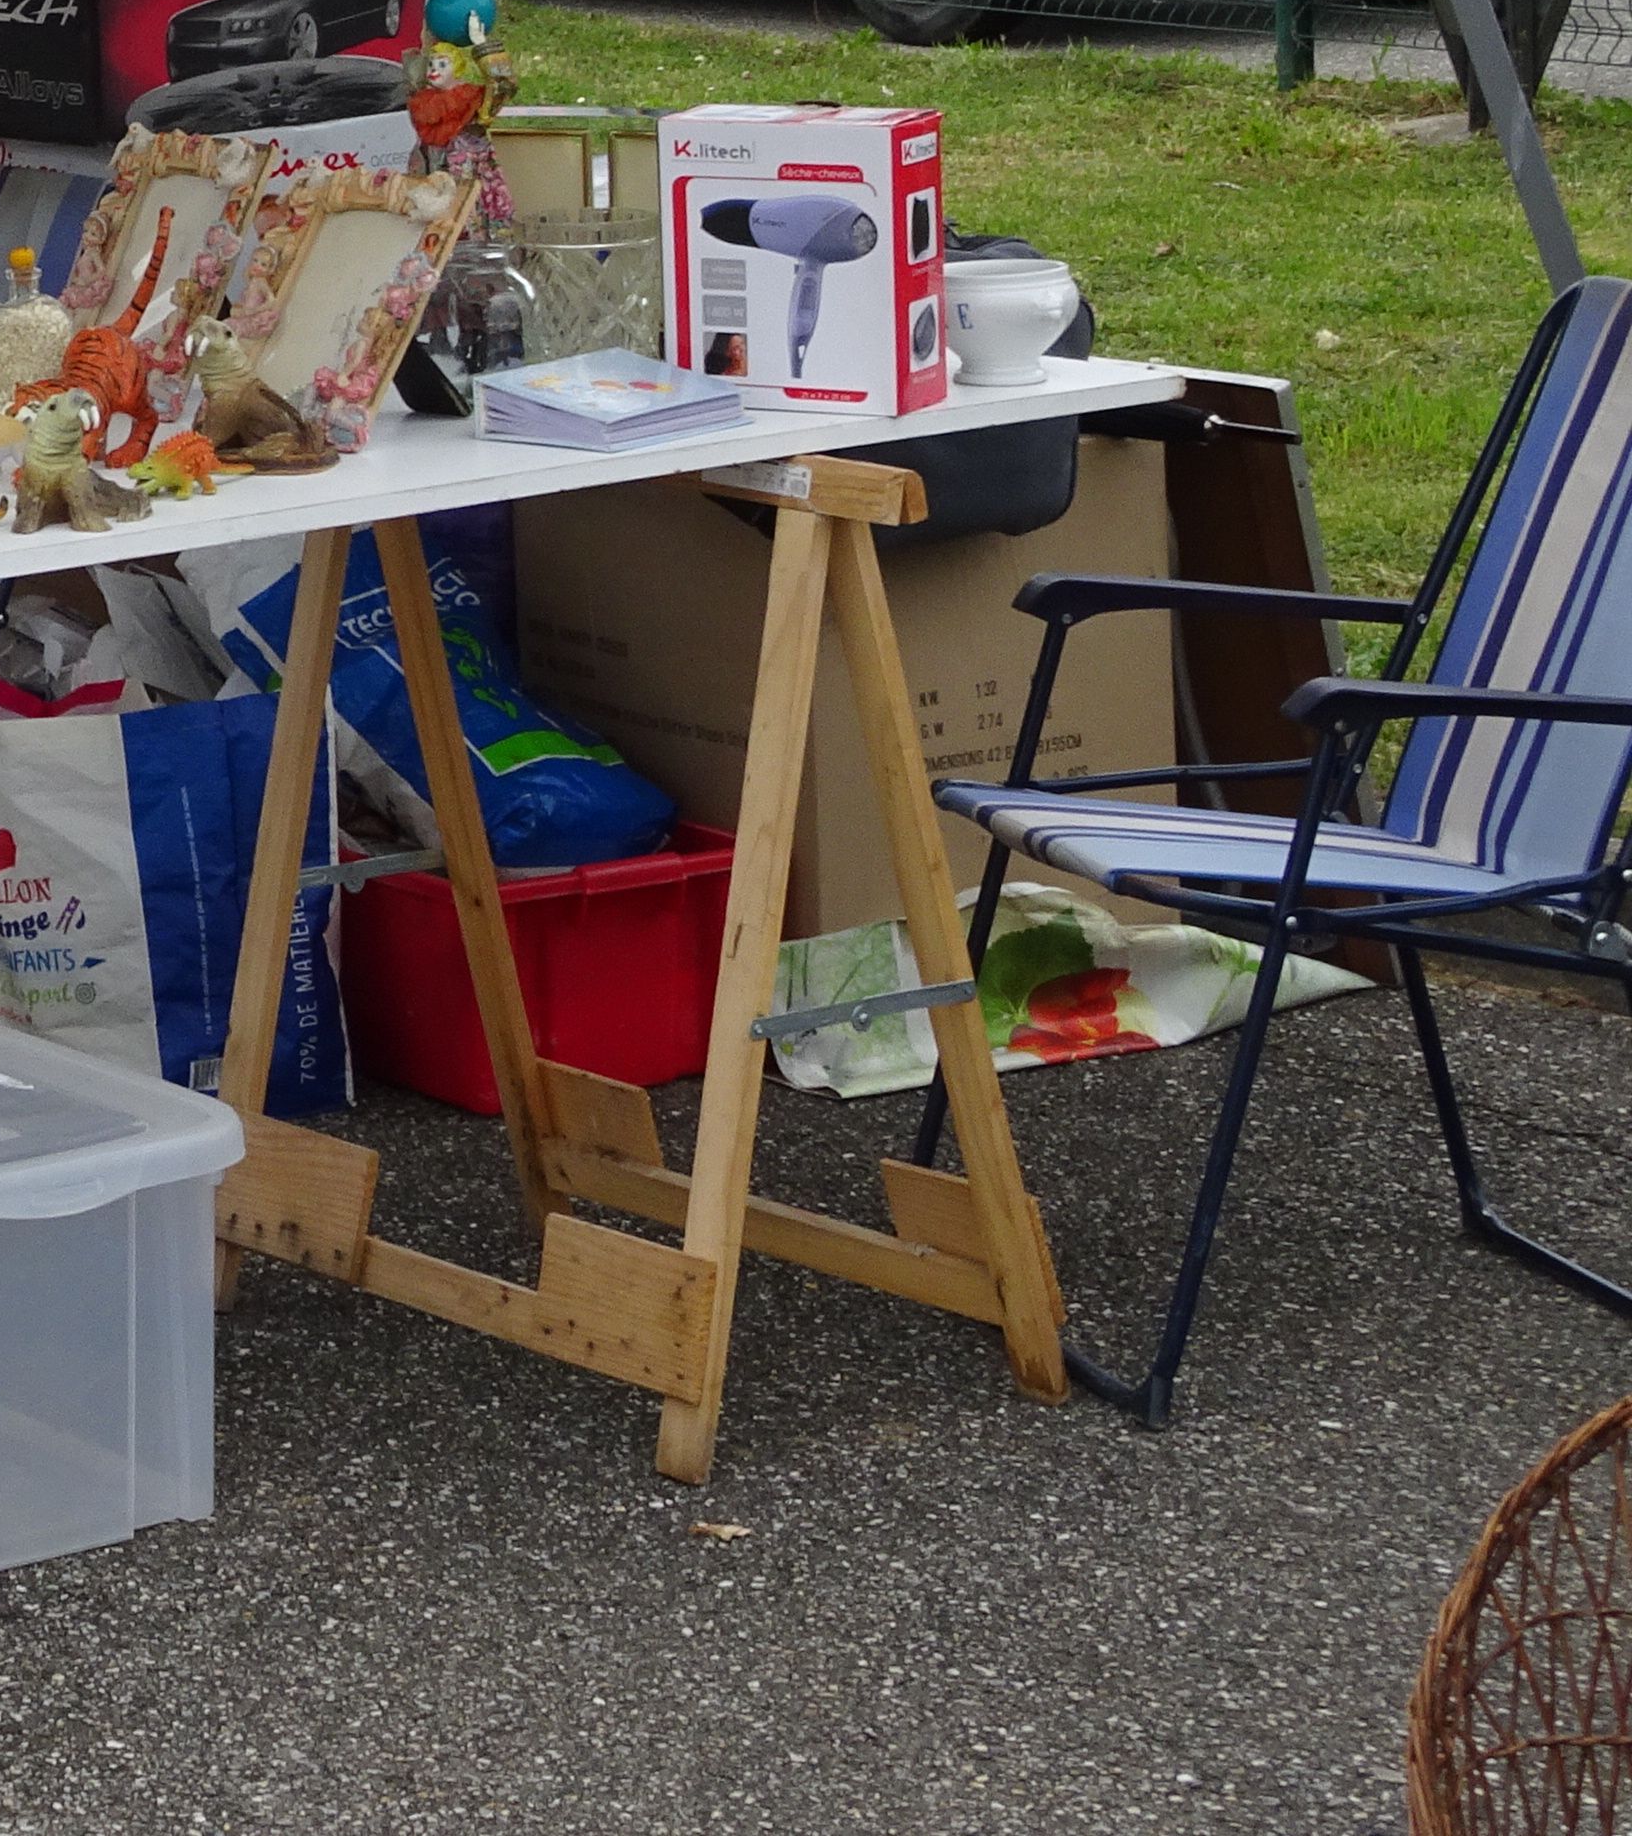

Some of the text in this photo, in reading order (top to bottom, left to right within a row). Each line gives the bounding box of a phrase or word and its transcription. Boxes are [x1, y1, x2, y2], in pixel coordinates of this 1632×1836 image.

[674, 139, 751, 161] K.litech
[296, 1001, 318, 1027] DE
[299, 1036, 318, 1084] 70%
